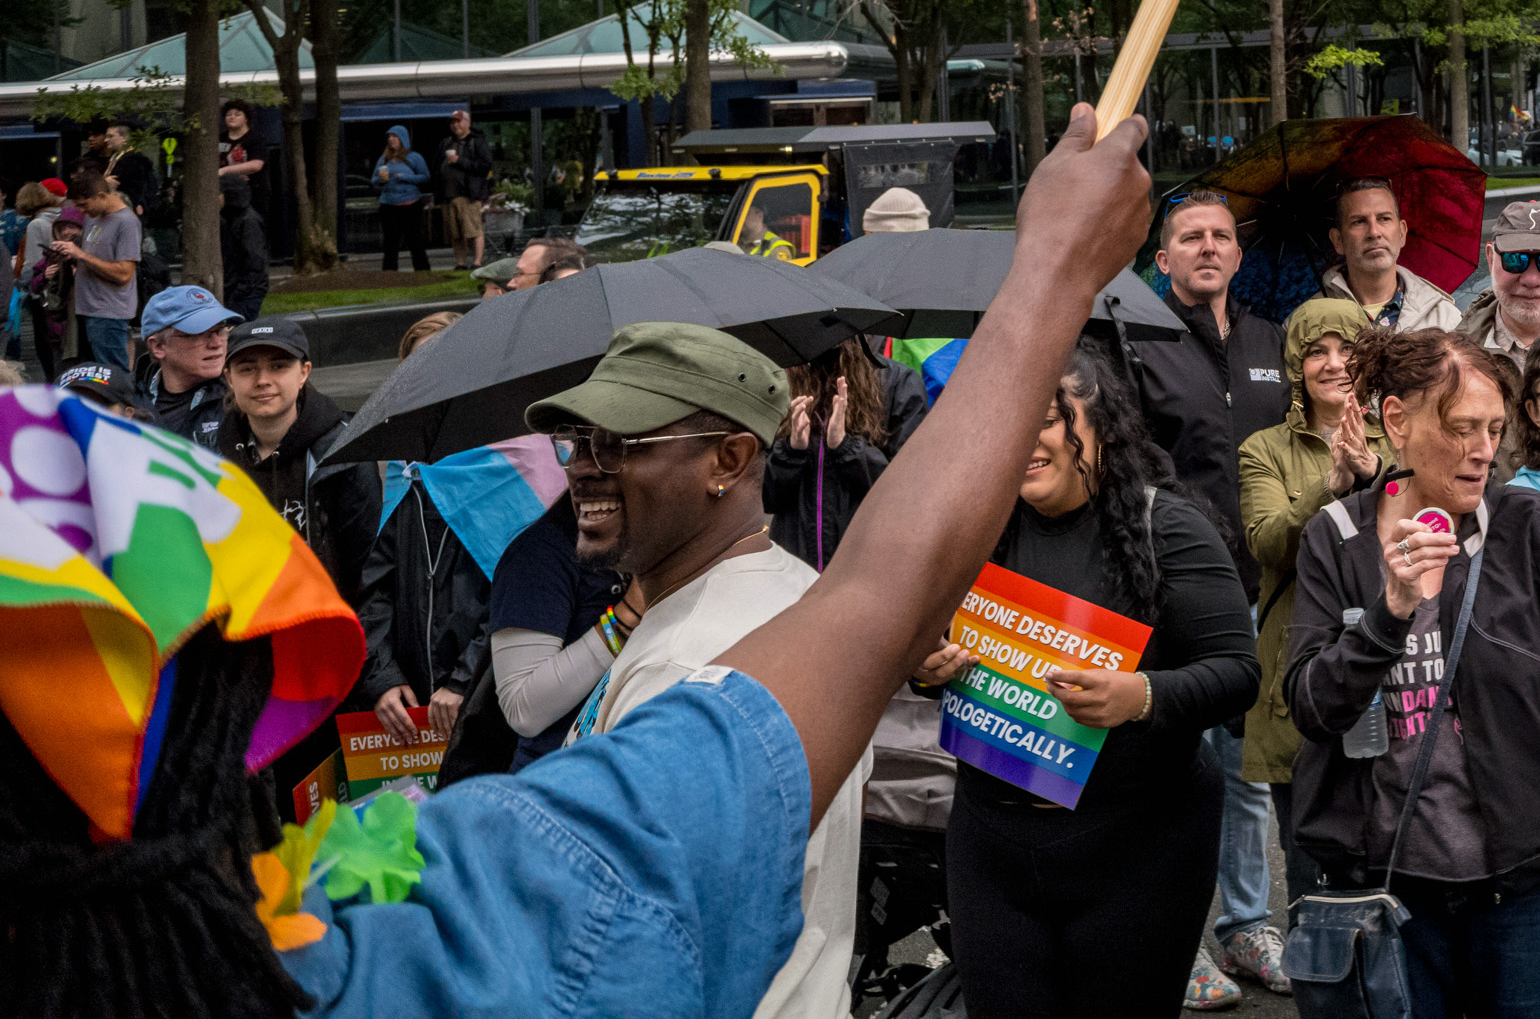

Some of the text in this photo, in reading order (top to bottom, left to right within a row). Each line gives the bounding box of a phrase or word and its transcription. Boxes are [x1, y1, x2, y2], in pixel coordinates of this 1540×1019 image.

[959, 625, 979, 650] TO
[978, 635, 1034, 672] SHOW
[962, 591, 1124, 672] ERYONE DESERVES
[1422, 658, 1445, 682] TO
[987, 676, 1058, 721] WORLD
[941, 688, 1076, 769] POLOGETICALLY.
[380, 751, 444, 771] TO SHOW
